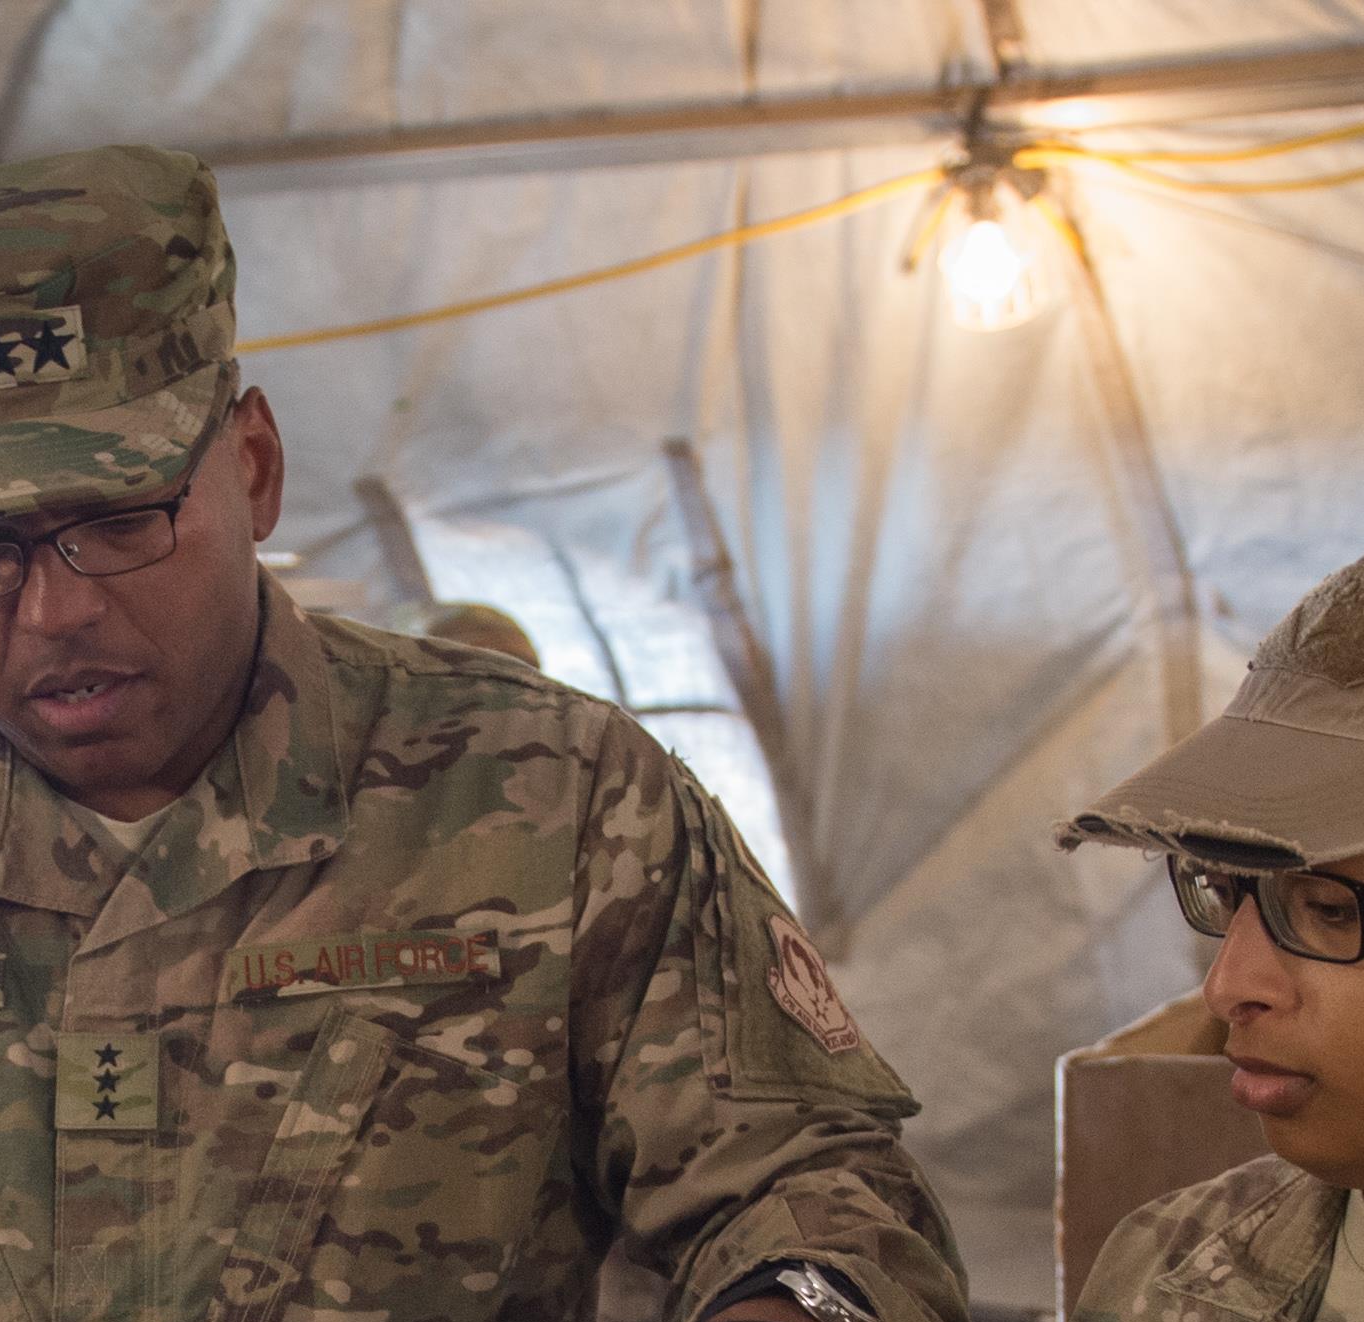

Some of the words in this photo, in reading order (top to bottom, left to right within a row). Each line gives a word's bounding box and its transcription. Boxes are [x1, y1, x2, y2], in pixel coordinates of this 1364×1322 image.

[243, 950, 304, 990] U.S.
[313, 944, 366, 985] AIR
[374, 933, 491, 978] FORCE
